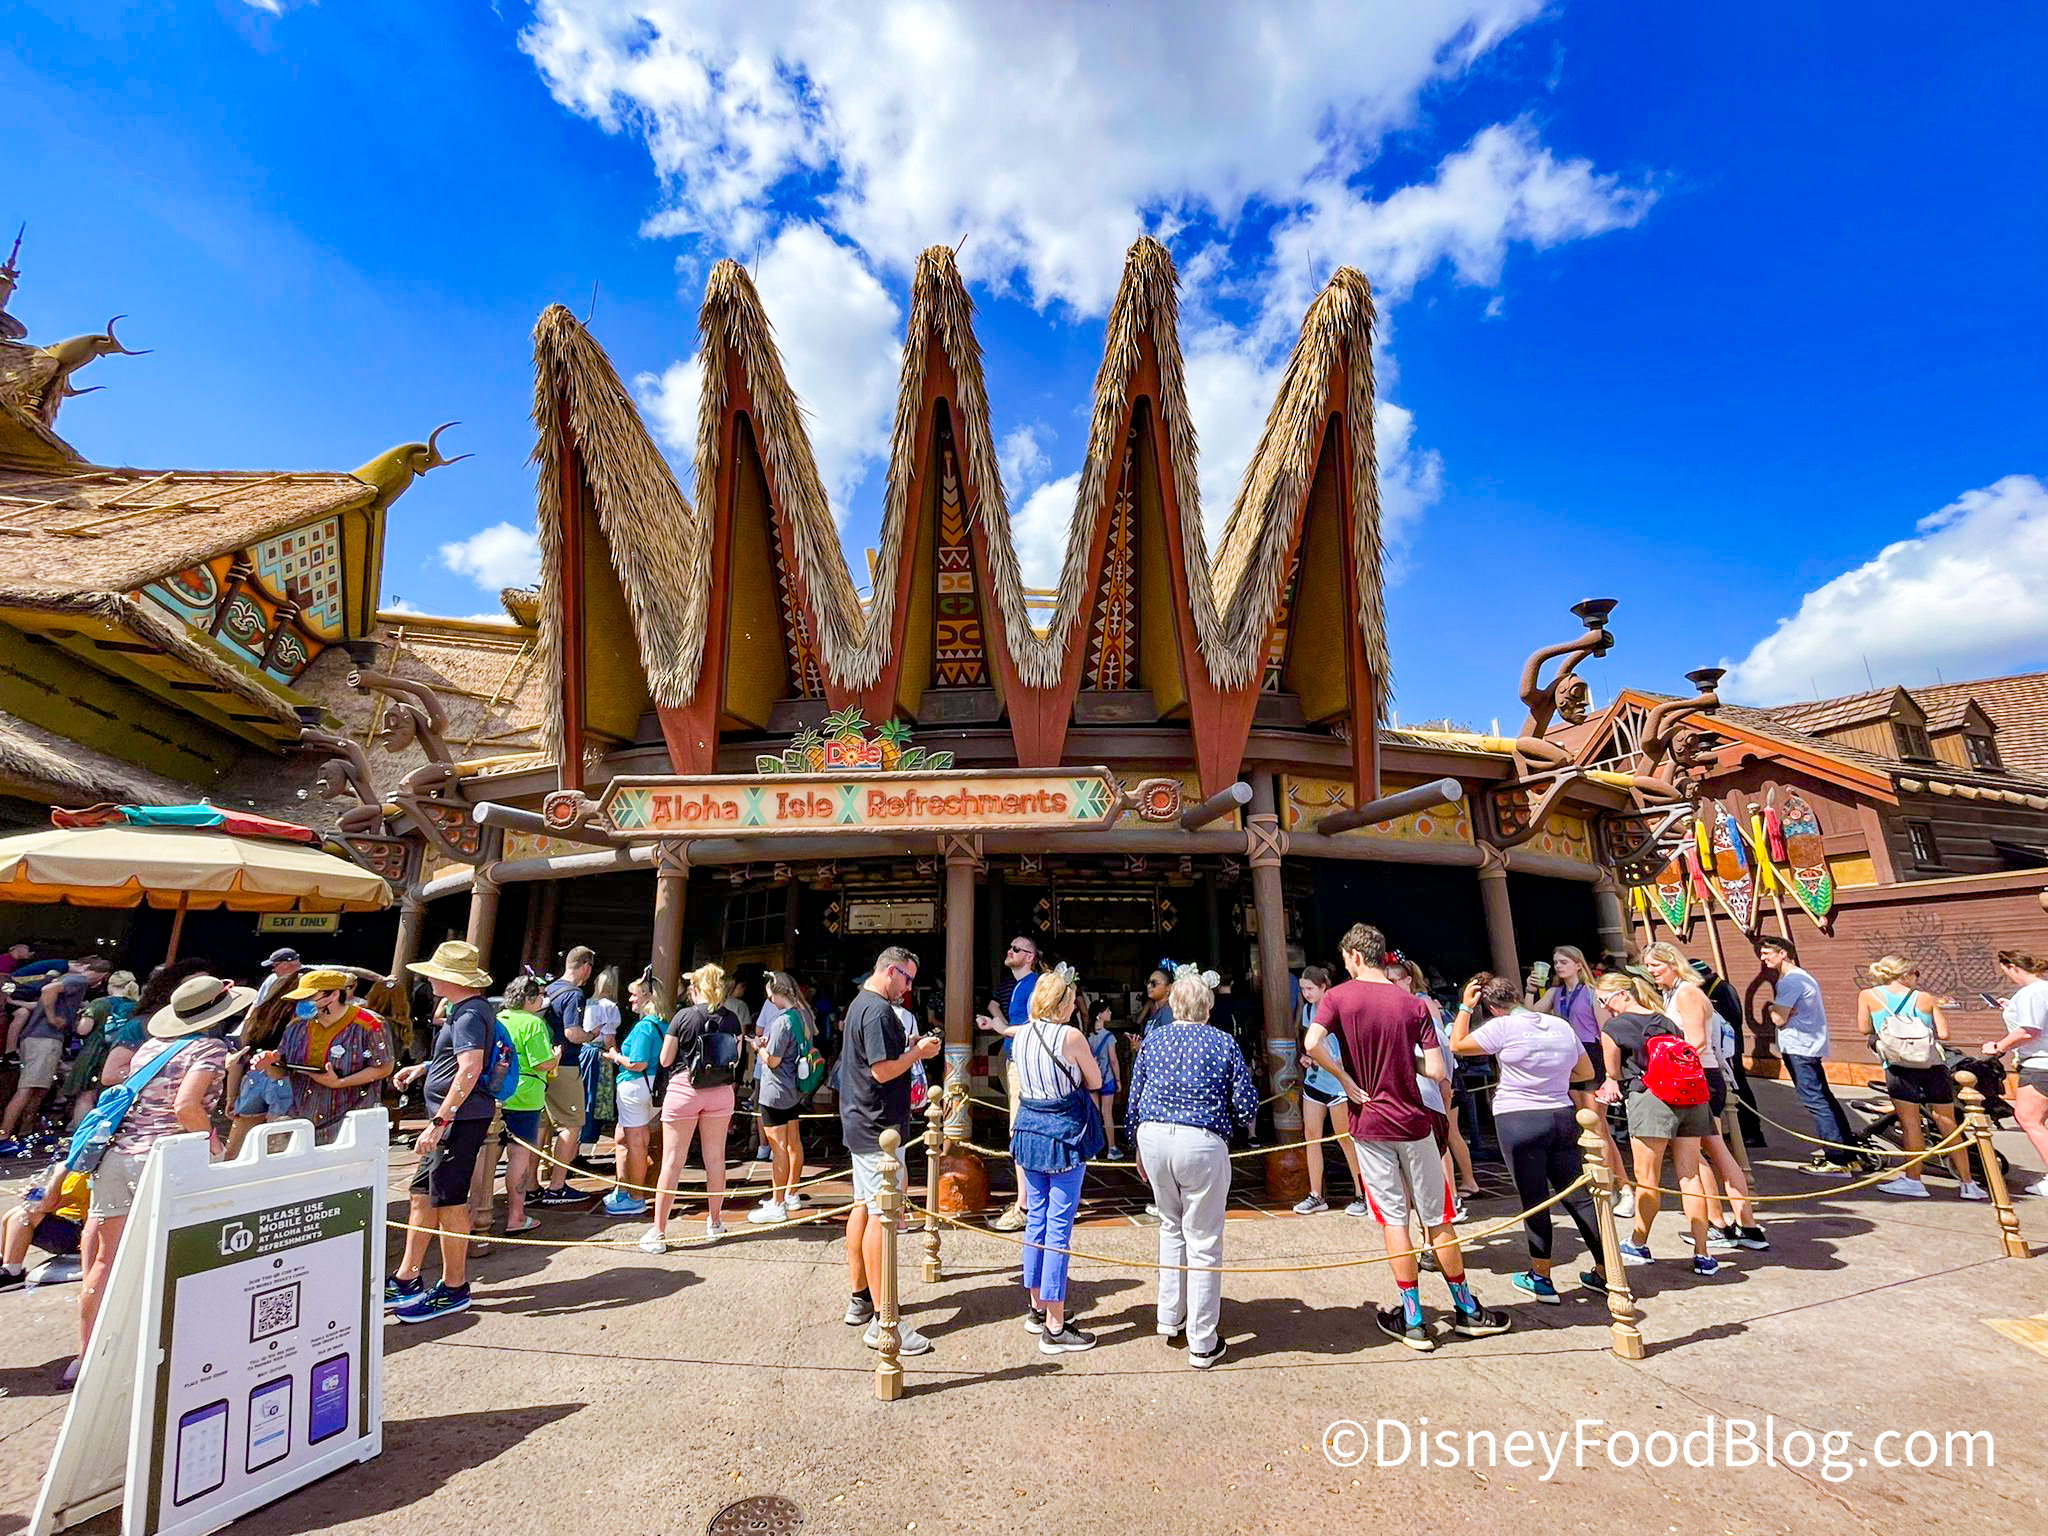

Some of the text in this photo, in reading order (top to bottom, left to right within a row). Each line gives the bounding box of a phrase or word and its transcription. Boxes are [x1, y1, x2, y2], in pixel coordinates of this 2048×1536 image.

[827, 739, 882, 764] Dole
[650, 786, 1068, 822] Aloha Isle Refreshments
[272, 917, 328, 927] EXIT ONLY
[259, 1202, 324, 1224] PLEASE USE
[259, 1207, 341, 1234] MOBILE ORDER
[256, 1231, 323, 1252] REFRESHMENTS
[258, 1222, 320, 1244] AT ALOHA ISLE
